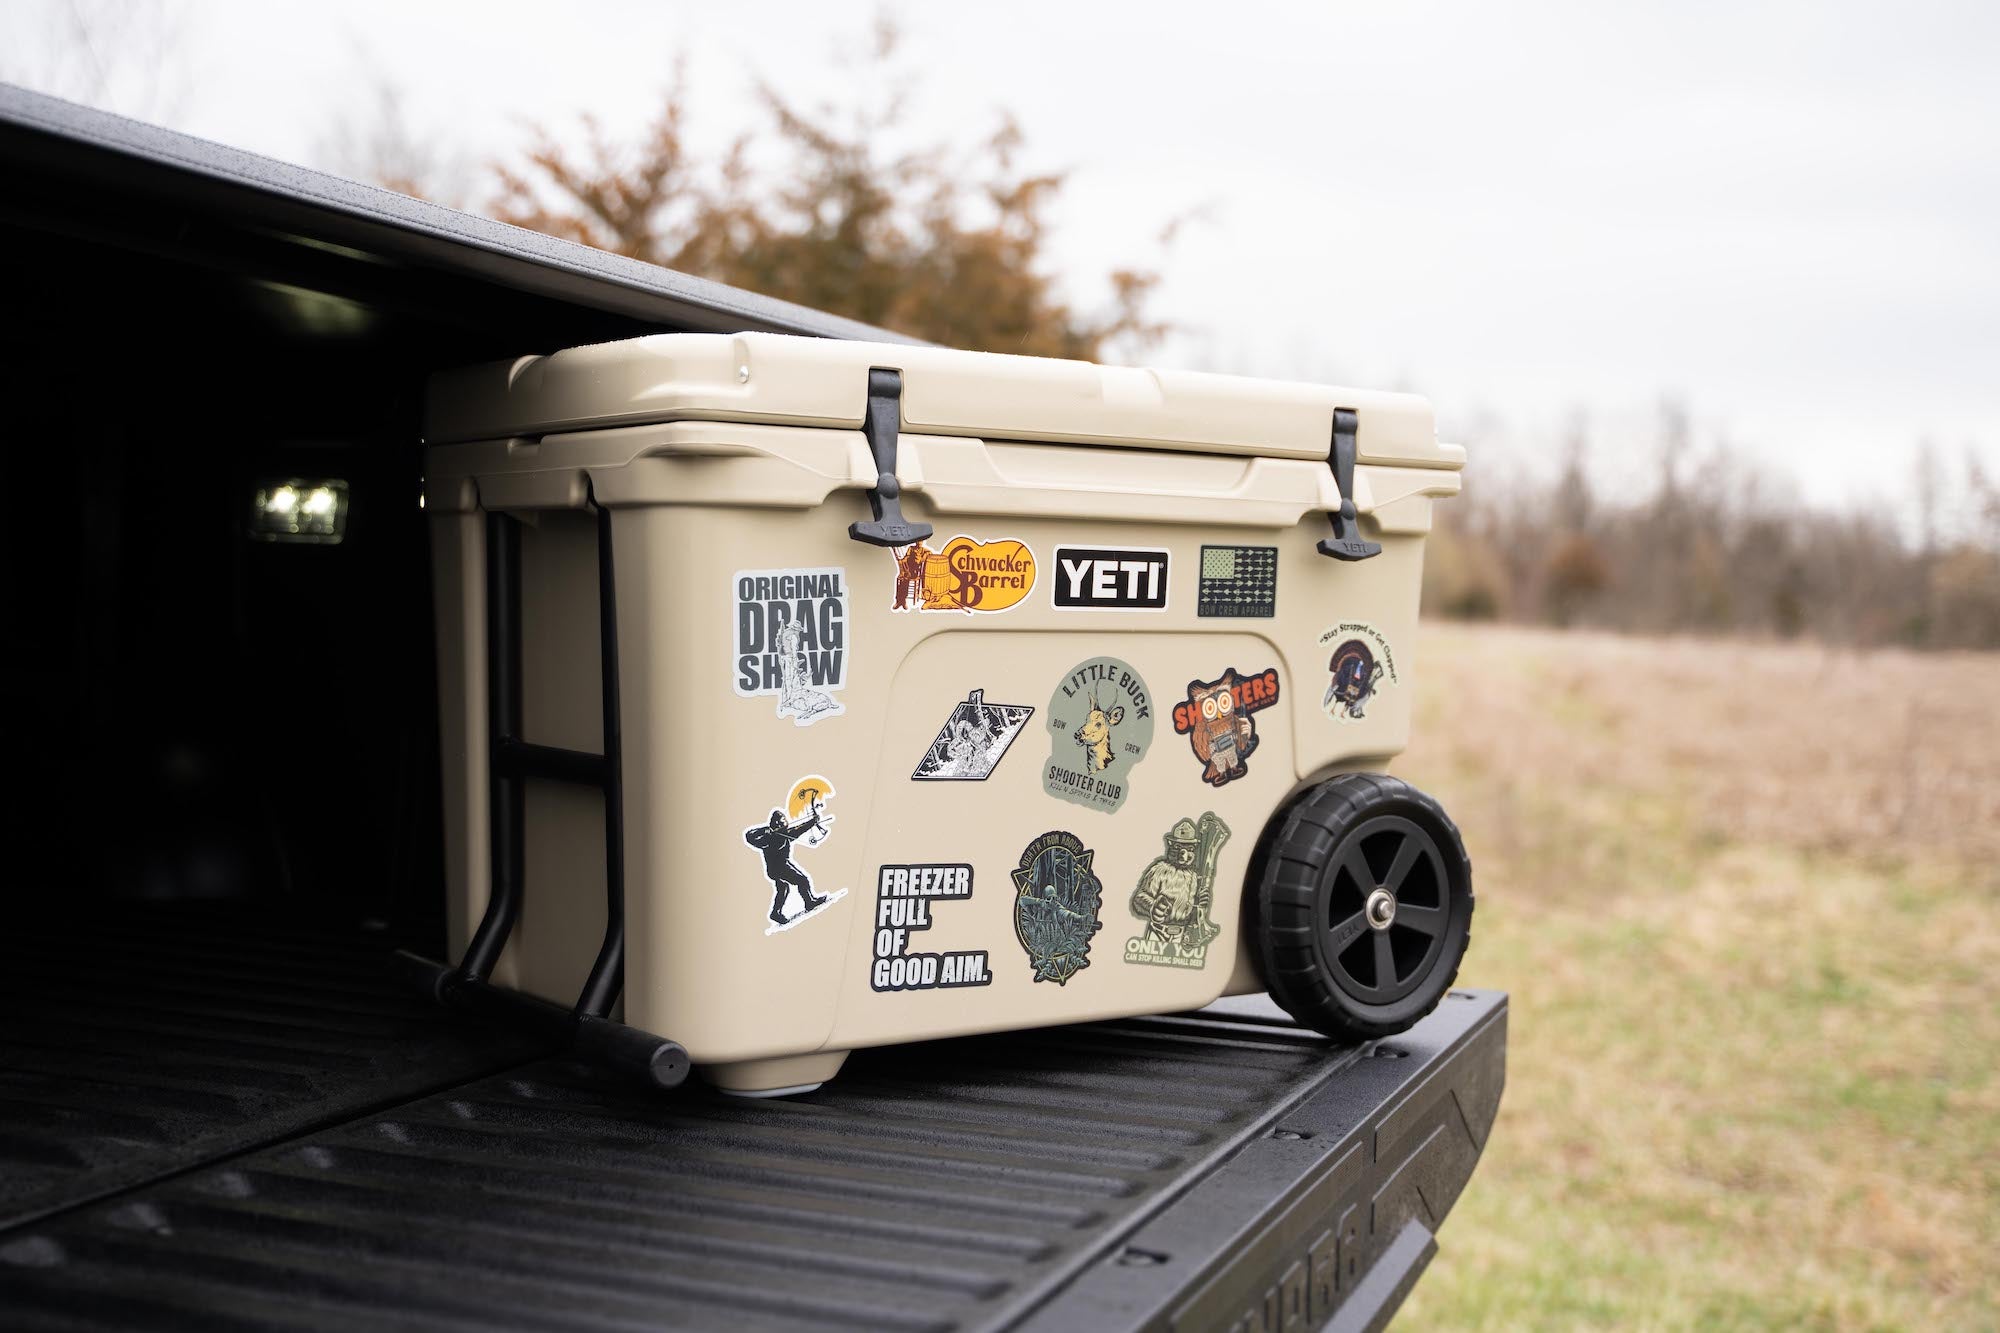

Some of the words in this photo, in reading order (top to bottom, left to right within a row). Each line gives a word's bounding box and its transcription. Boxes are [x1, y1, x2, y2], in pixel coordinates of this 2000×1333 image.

[880, 525, 911, 537] YETI
[1343, 542, 1367, 553] YETI
[948, 545, 1032, 594] Schwacker
[1061, 559, 1160, 600] YETI
[739, 574, 843, 602] ORIGINAL
[958, 571, 1026, 607] Barrel
[1200, 605, 1216, 616] BOW
[1218, 605, 1238, 616] CREW
[1241, 606, 1272, 617] APPAREL
[739, 598, 843, 655] DRAG
[1063, 664, 1118, 699] LITTLE
[1119, 671, 1149, 720] BUCK
[1053, 718, 1067, 730] BOW
[1124, 742, 1141, 755] CREW
[1049, 766, 1095, 793] SHOOTER
[1096, 779, 1121, 800] CLUB
[1022, 841, 1042, 867] DEATH
[1042, 834, 1060, 847] FROM
[1061, 835, 1081, 854] ABOVE
[881, 867, 970, 896] FREEZER
[879, 898, 928, 927] FULL
[876, 928, 906, 957] OF
[1127, 939, 1169, 955] ONLY
[874, 957, 938, 988] GOOD
[939, 955, 988, 983] AIM.
[1138, 954, 1152, 962] STOP
[1152, 955, 1172, 964] KILLING
